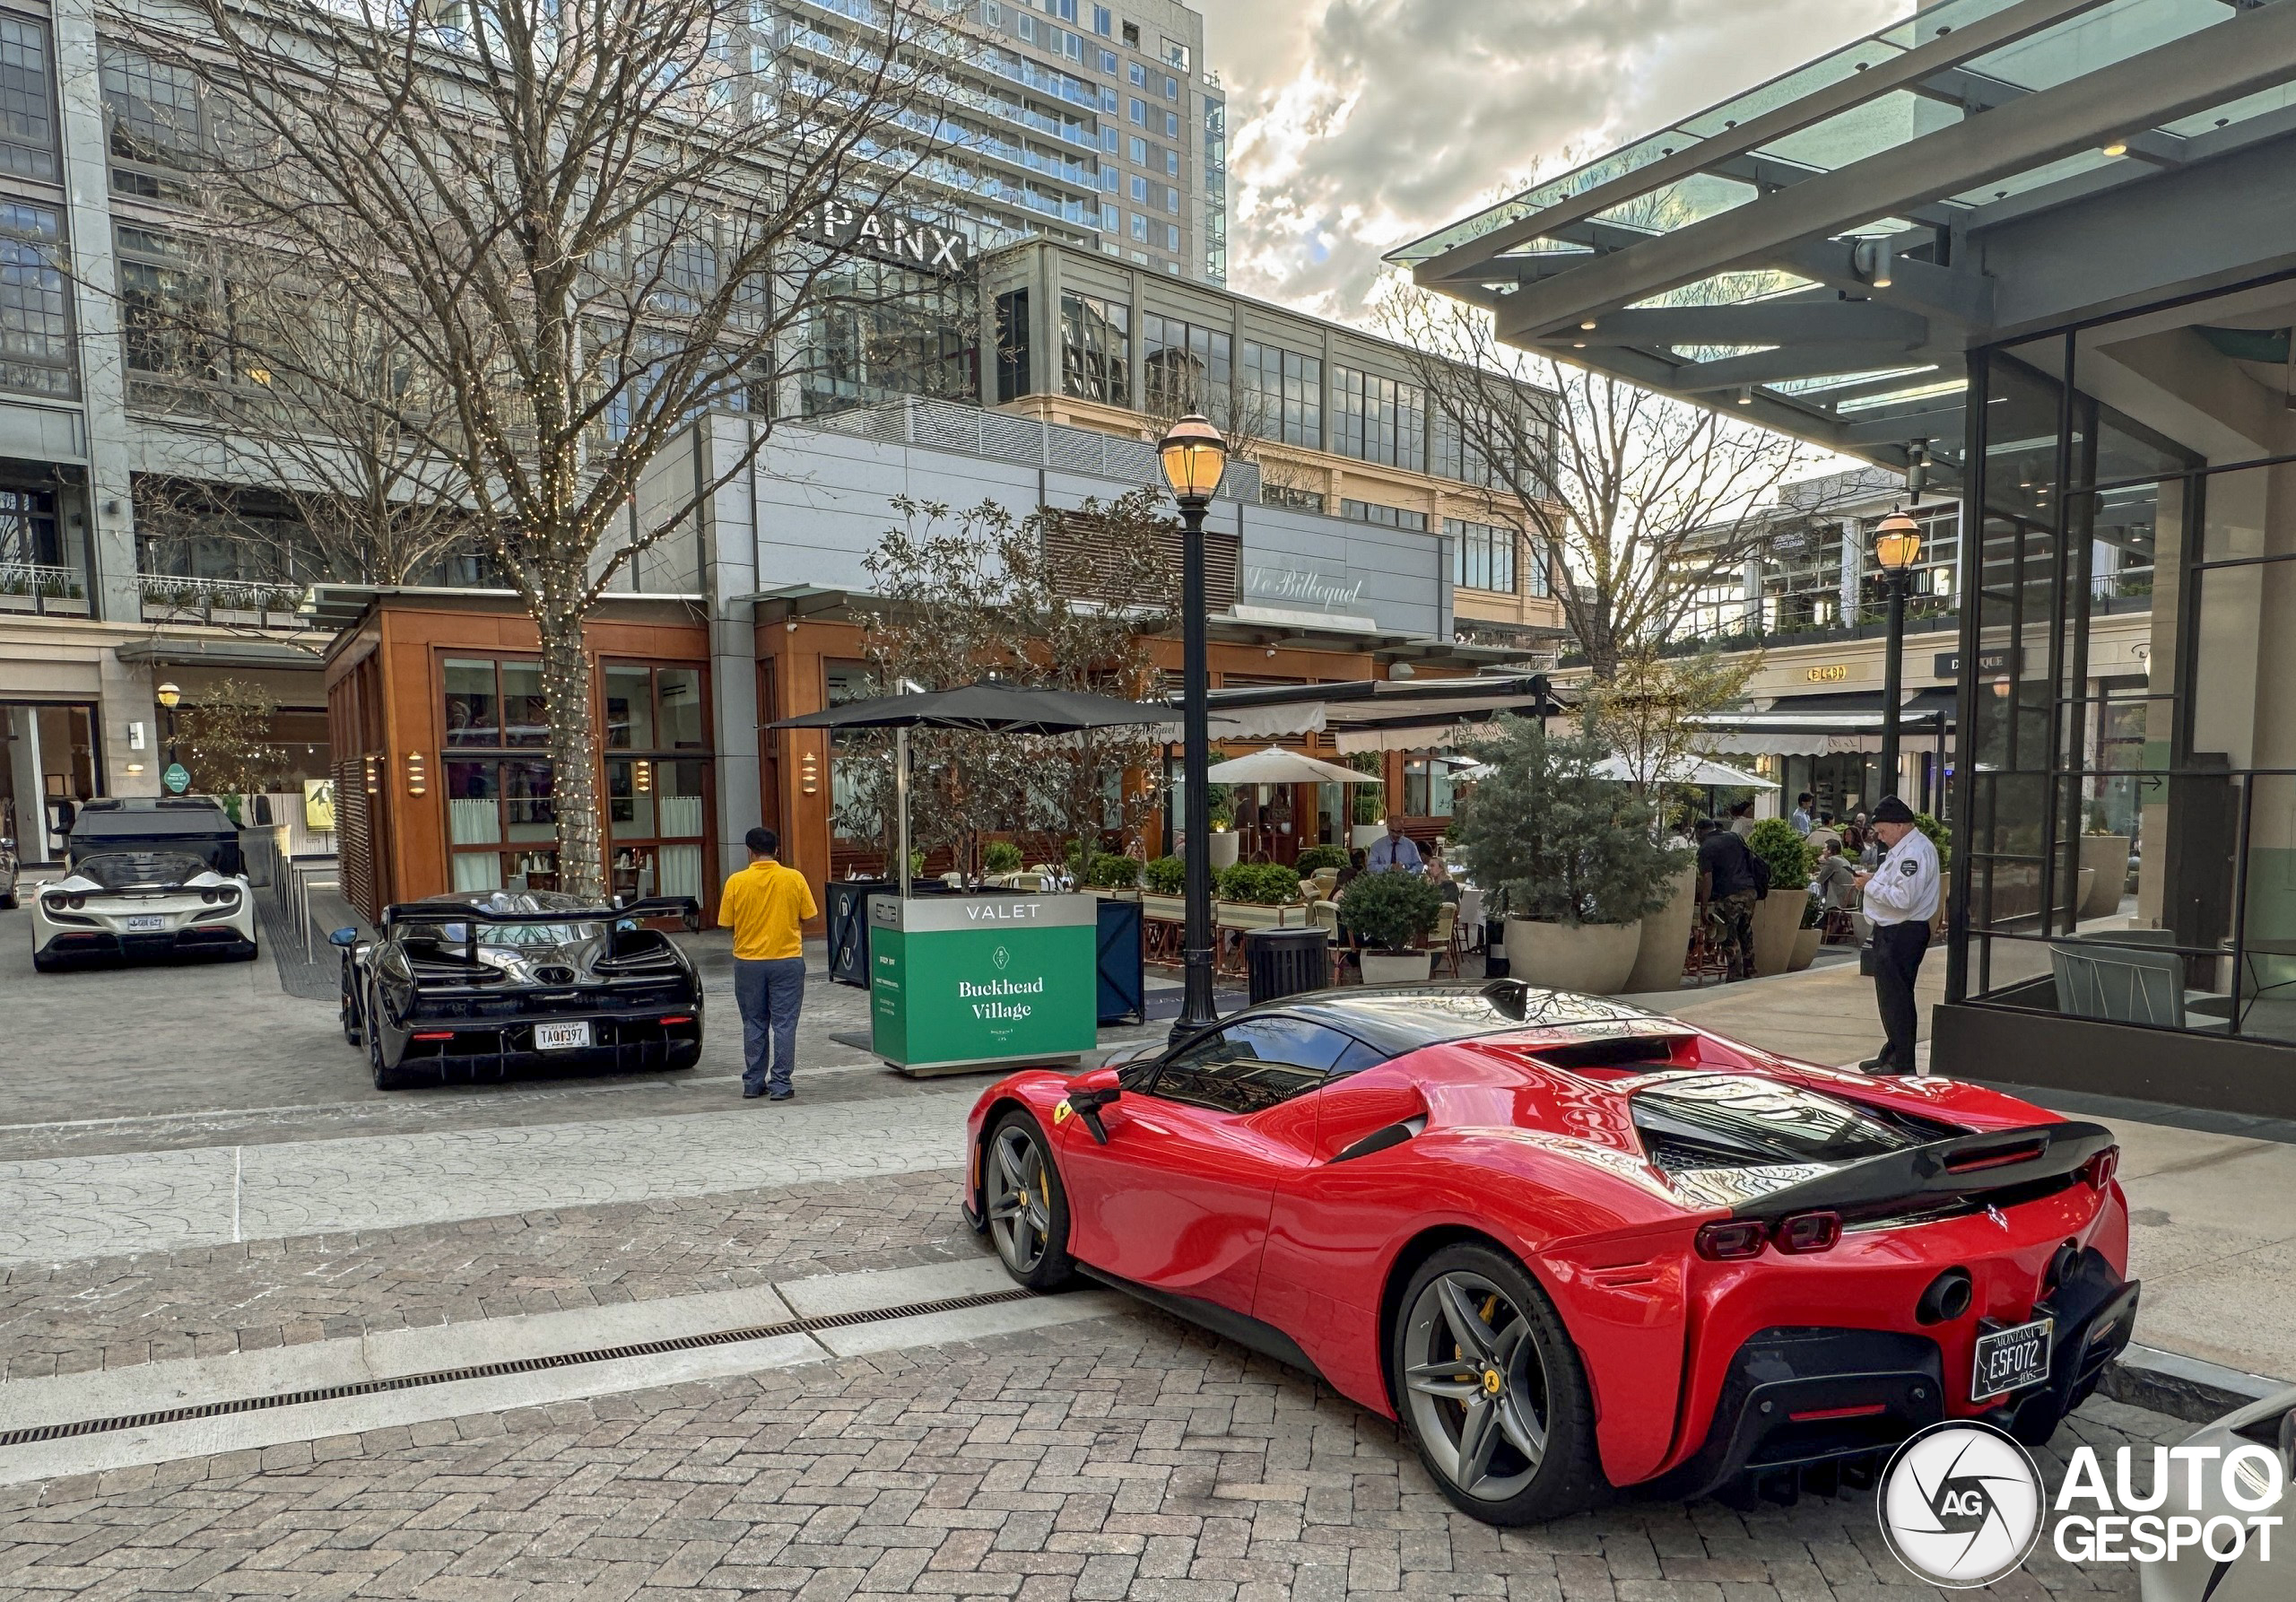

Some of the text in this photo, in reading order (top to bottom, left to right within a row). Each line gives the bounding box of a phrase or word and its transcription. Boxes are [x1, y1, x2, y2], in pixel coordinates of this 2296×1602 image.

[966, 904, 1040, 920] VALET
[959, 976, 1043, 997] Buckhead
[972, 1002, 1031, 1021] Village
[1989, 1339, 2039, 1380] ESF072
